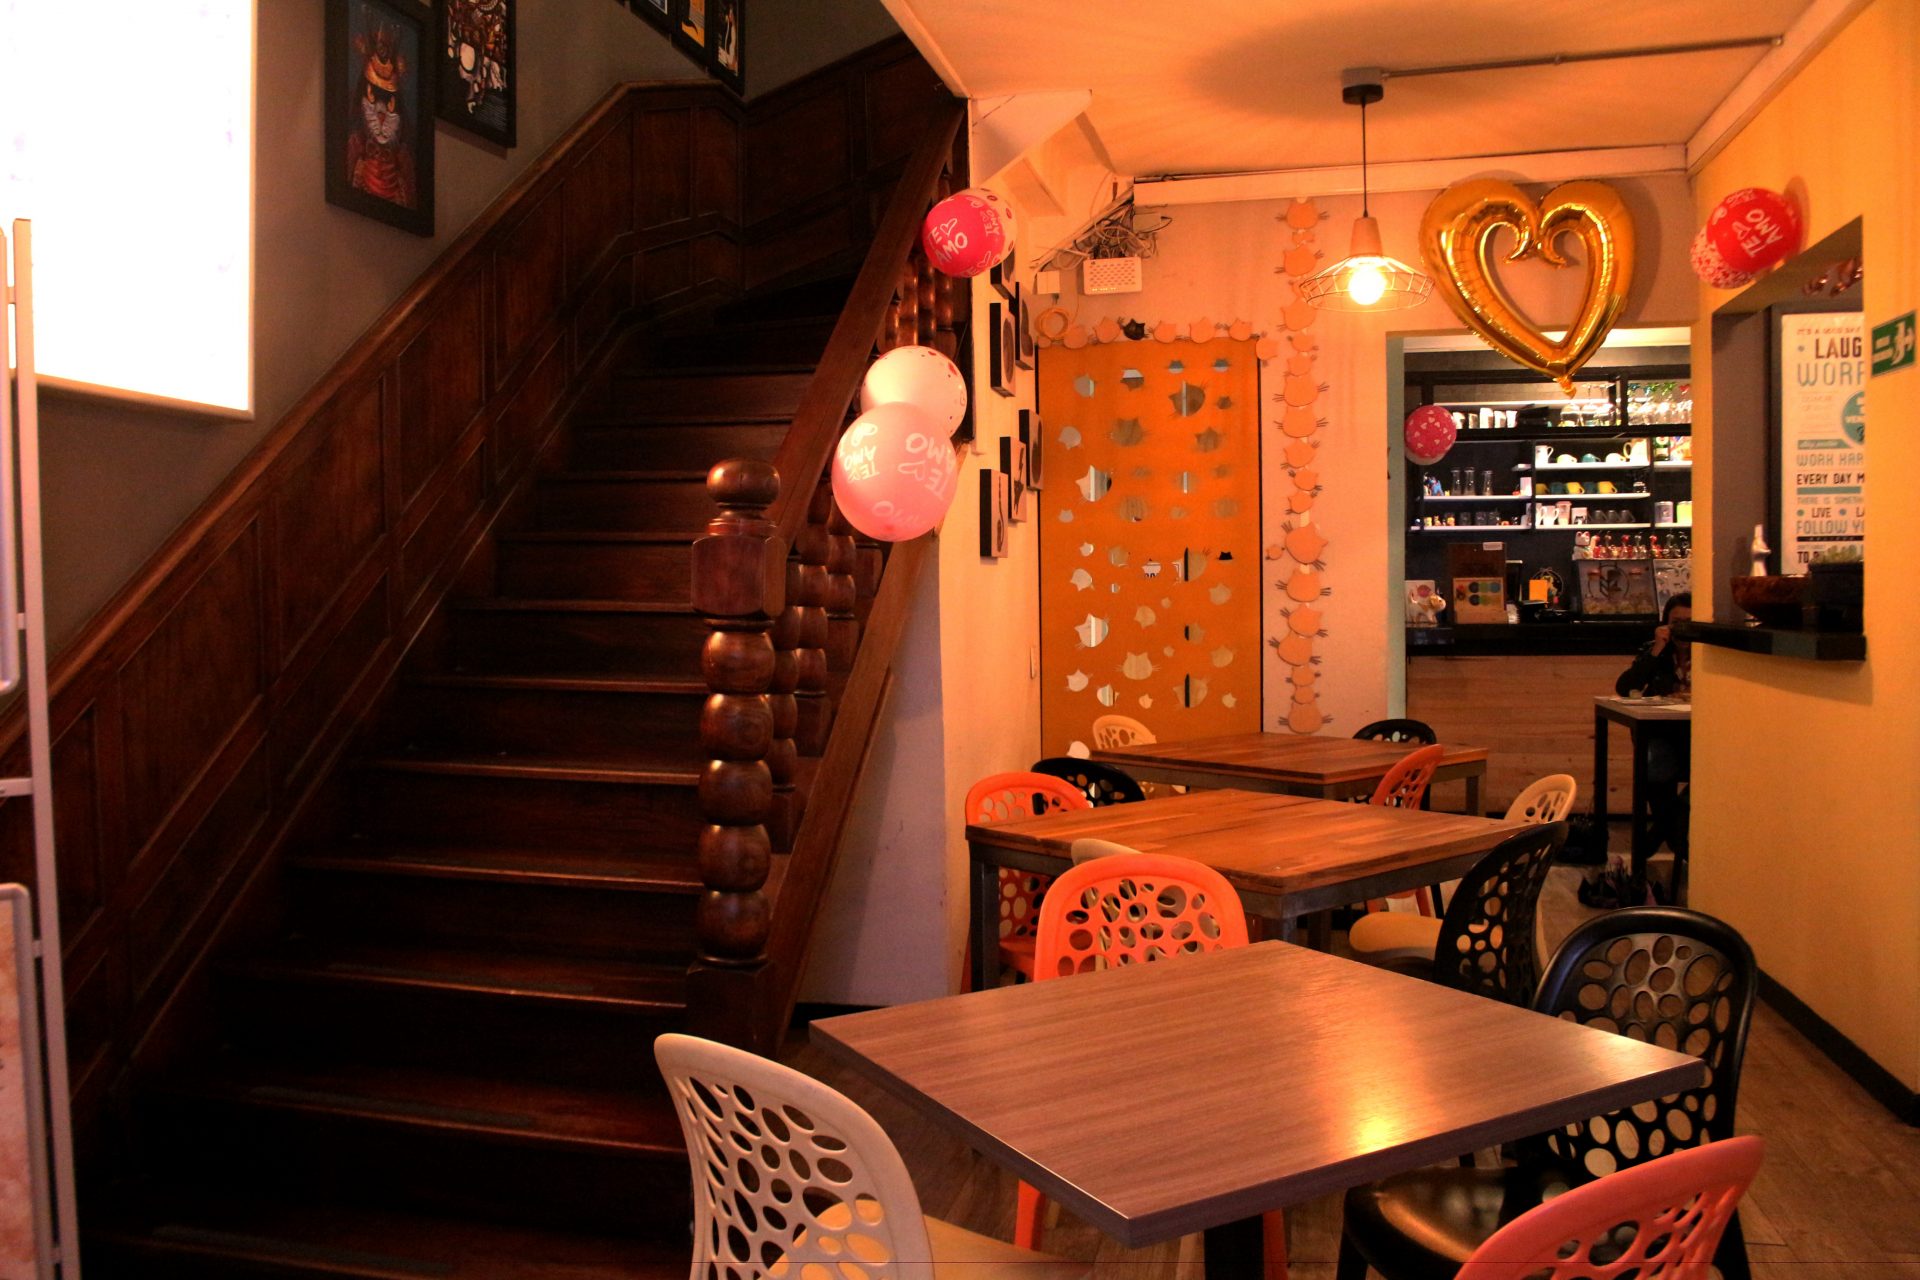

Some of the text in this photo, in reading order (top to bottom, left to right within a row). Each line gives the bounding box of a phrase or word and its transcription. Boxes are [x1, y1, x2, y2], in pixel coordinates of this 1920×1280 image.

[1746, 208, 1783, 245] AMO
[934, 231, 968, 266] AMO
[1815, 336, 1863, 359] LAUG
[1796, 473, 1828, 485] EVERY
[1833, 472, 1852, 485] DAY
[1812, 507, 1832, 518] LIVE
[1796, 520, 1848, 535] FOLLOW
